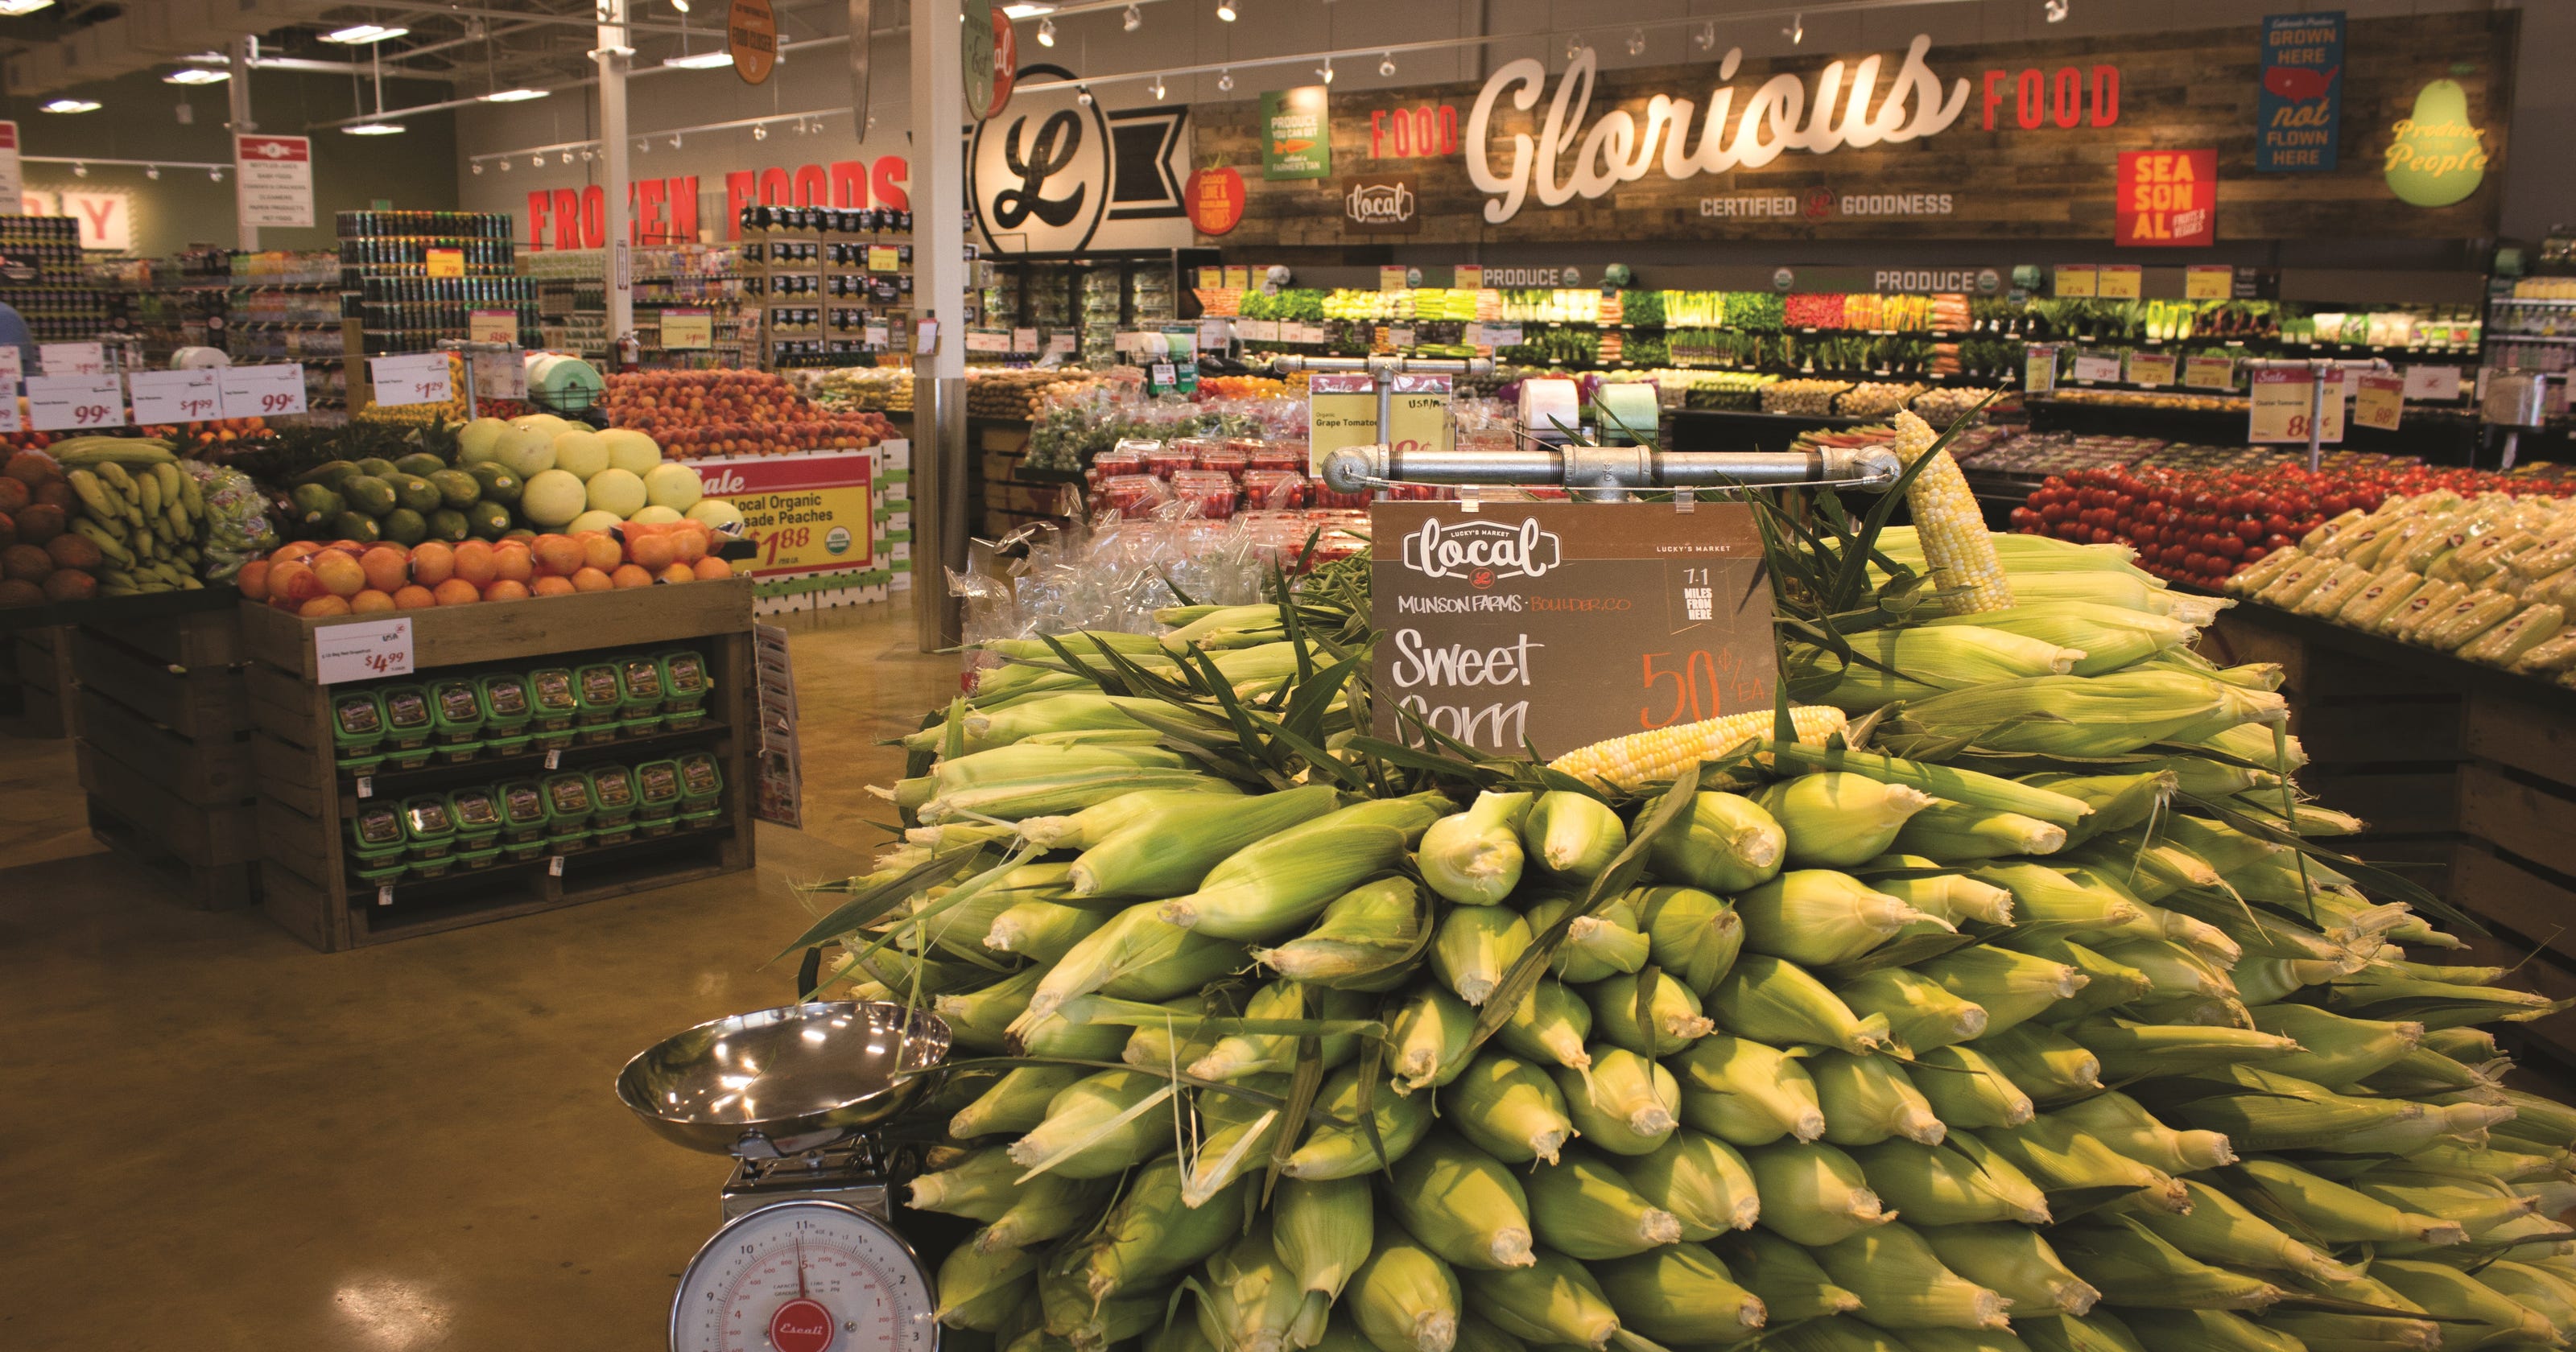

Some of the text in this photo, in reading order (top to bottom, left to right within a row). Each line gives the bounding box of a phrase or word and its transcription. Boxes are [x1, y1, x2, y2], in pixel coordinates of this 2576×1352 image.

[2268, 27, 2337, 47] GROWN
[2277, 47, 2326, 65] HERE
[1983, 64, 2120, 132] FOOD
[1270, 115, 1319, 129] PRODUCE
[2270, 97, 2330, 128] not
[1371, 105, 1458, 159] FOOD
[1465, 34, 1971, 225] Glorious
[2265, 129, 2330, 146] FLOWN
[2391, 118, 2486, 142] Produce
[2272, 149, 2320, 166] HERE
[2384, 142, 2489, 179] People
[993, 109, 1086, 230] L
[2135, 154, 2195, 182] SEA
[527, 155, 909, 252] FROEN FOODS
[1353, 182, 1408, 223] local
[1699, 196, 1797, 217] CERTIFIED
[1841, 194, 1953, 216] GOODNESS
[2134, 183, 2193, 211] SON
[2132, 212, 2171, 239] AL
[1483, 269, 1559, 286] PRODUCE
[1875, 271, 1975, 291] PRODUCE
[1317, 377, 1354, 394] Sale
[2258, 369, 2287, 383] Sale
[261, 393, 295, 413] 99¢
[74, 405, 112, 424] 99¢
[1316, 418, 1377, 429] Grape Tomatoe
[770, 493, 823, 512] Organic
[743, 509, 834, 528] sade Peaches
[1451, 530, 1510, 538] LUCKY'S MARKET
[1420, 517, 1547, 578] local
[1695, 545, 1732, 553] MARKET
[1682, 567, 1709, 586] 7.1
[1683, 587, 1713, 600] MILES
[1397, 595, 1469, 614] MUNSON
[1472, 594, 1523, 613] FARMS
[1686, 598, 1713, 610] FROM
[1687, 608, 1713, 620] HERE
[382, 632, 399, 642] USA
[365, 651, 404, 674] $499
[1392, 628, 1546, 688] Sweet
[1395, 695, 1530, 749] Corn
[741, 1244, 754, 1255] 10
[899, 1275, 907, 1285] 2
[707, 1292, 714, 1301] 9
[734, 1310, 741, 1320] 4
[780, 1323, 824, 1336] Escali
[912, 1331, 919, 1342] 3
